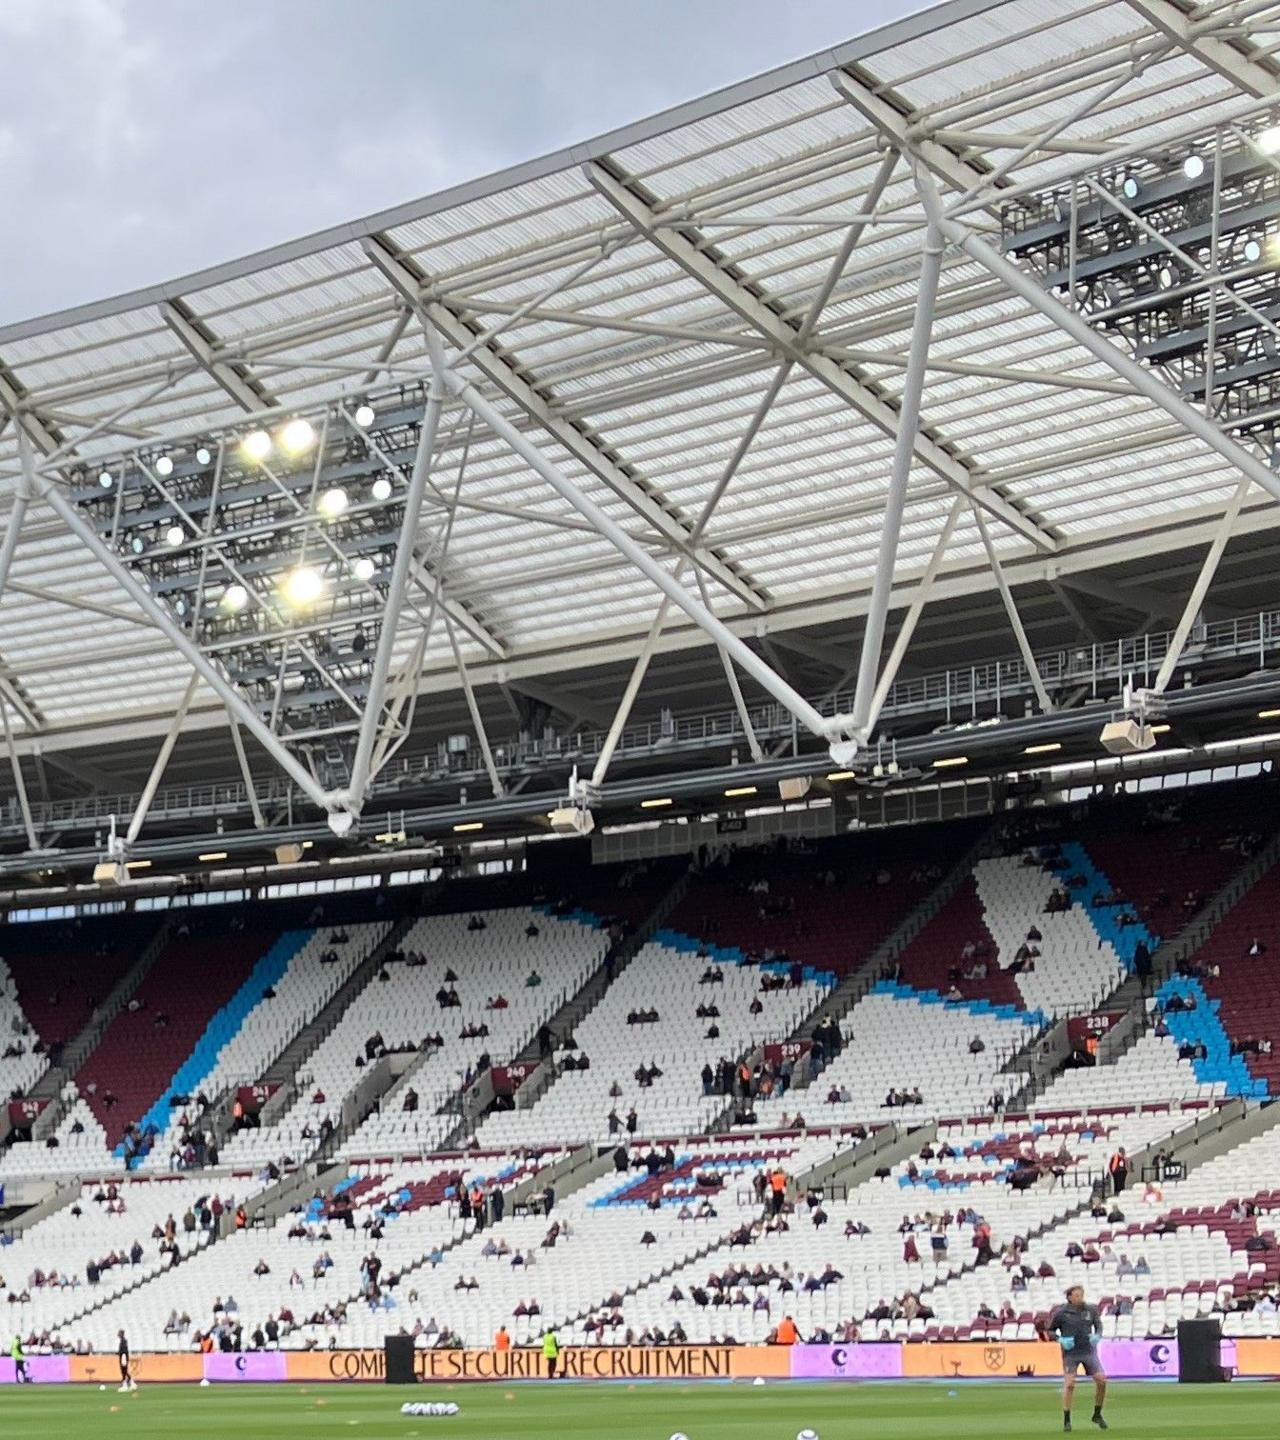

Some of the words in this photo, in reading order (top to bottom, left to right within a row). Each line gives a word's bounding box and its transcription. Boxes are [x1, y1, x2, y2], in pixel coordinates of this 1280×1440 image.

[1086, 1016, 1108, 1029] 238
[780, 1043, 800, 1057] 239
[505, 1066, 525, 1078] 240
[252, 1086, 269, 1097] 241
[1165, 1166, 1181, 1176] 137
[447, 1350, 544, 1376] SECURIT
[562, 1348, 735, 1377] RECRUITMENT
